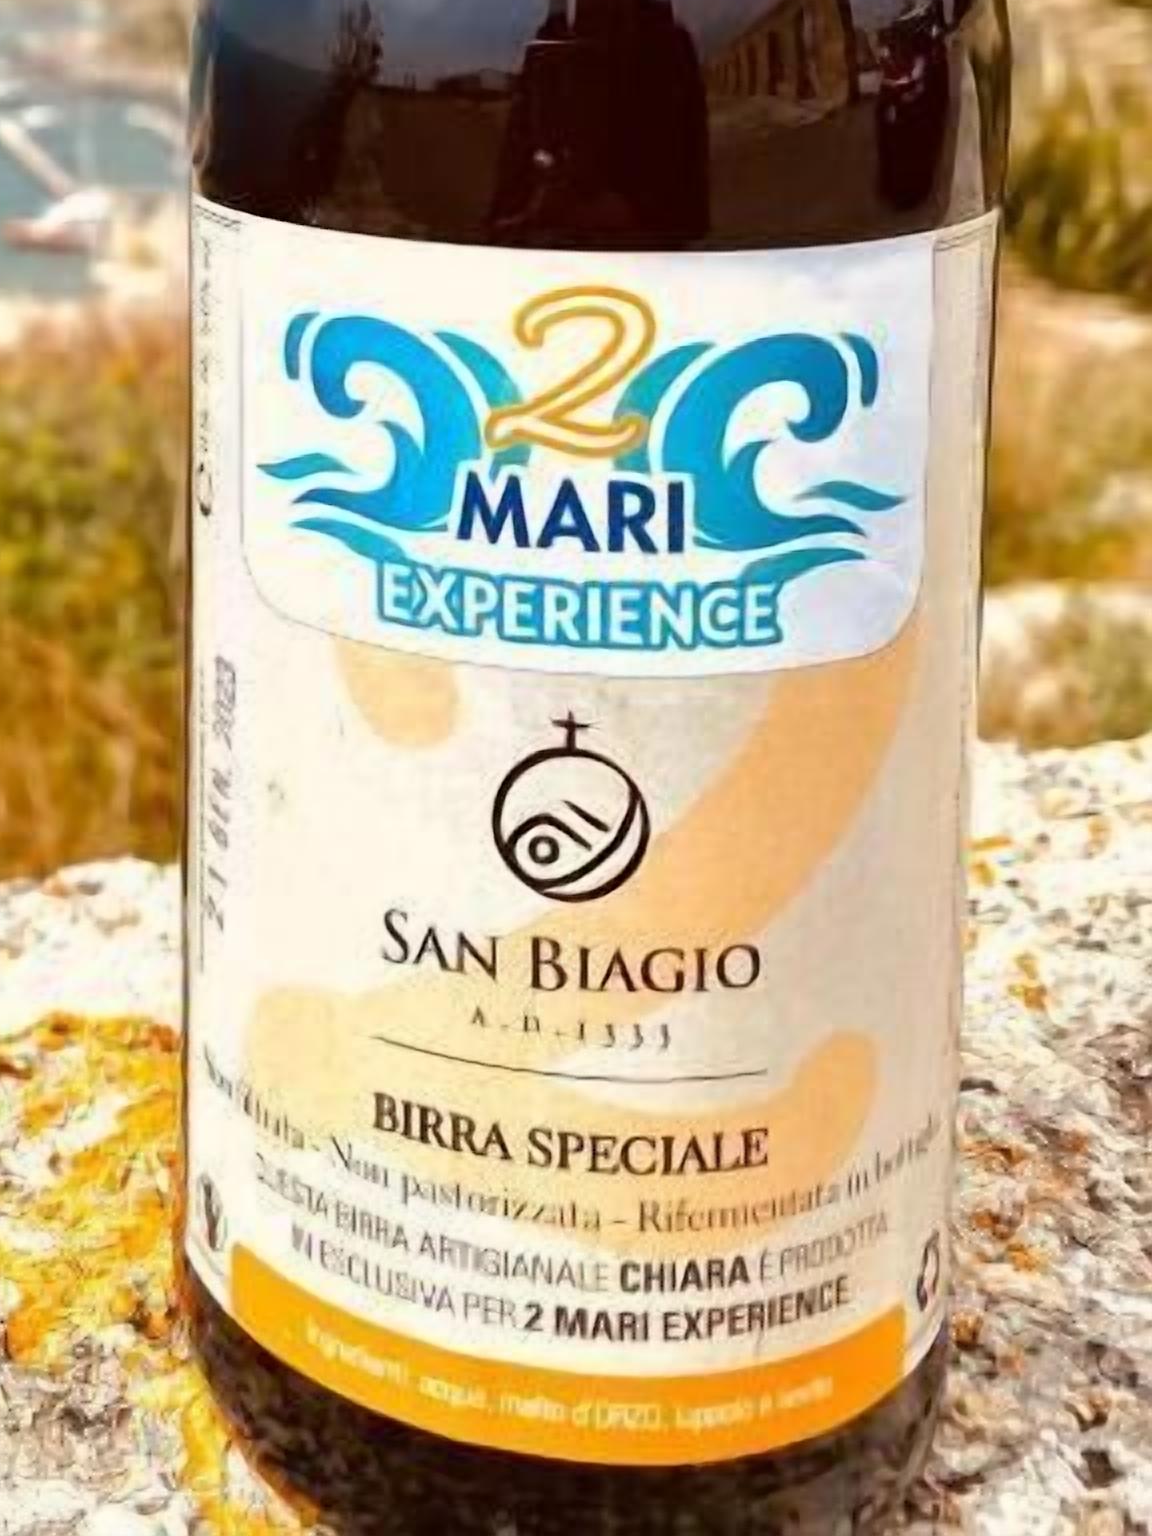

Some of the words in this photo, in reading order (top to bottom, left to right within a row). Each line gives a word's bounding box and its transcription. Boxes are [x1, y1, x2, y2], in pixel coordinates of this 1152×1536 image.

[484, 284, 656, 458] 2
[455, 471, 687, 555] MARI
[379, 561, 783, 649] EXPERIENCE
[382, 907, 502, 981] SAN
[529, 935, 761, 993] BIAGIO
[373, 1091, 512, 1161] BIRRA
[527, 1126, 769, 1176] SPECIALE
[401, 1173, 600, 1233] pastorizzata
[638, 1180, 841, 1232] Rifermentata
[320, 1238, 456, 1314] ESCLUSIVA
[463, 1290, 518, 1328] PER
[523, 1302, 544, 1332] 2
[554, 1304, 649, 1342] MARI
[662, 1274, 849, 1342] EXPERIENCE
[336, 1199, 410, 1253] BIRRA
[420, 1230, 610, 1293] ARTIGIANALE
[620, 1254, 751, 1295] CHIARA
